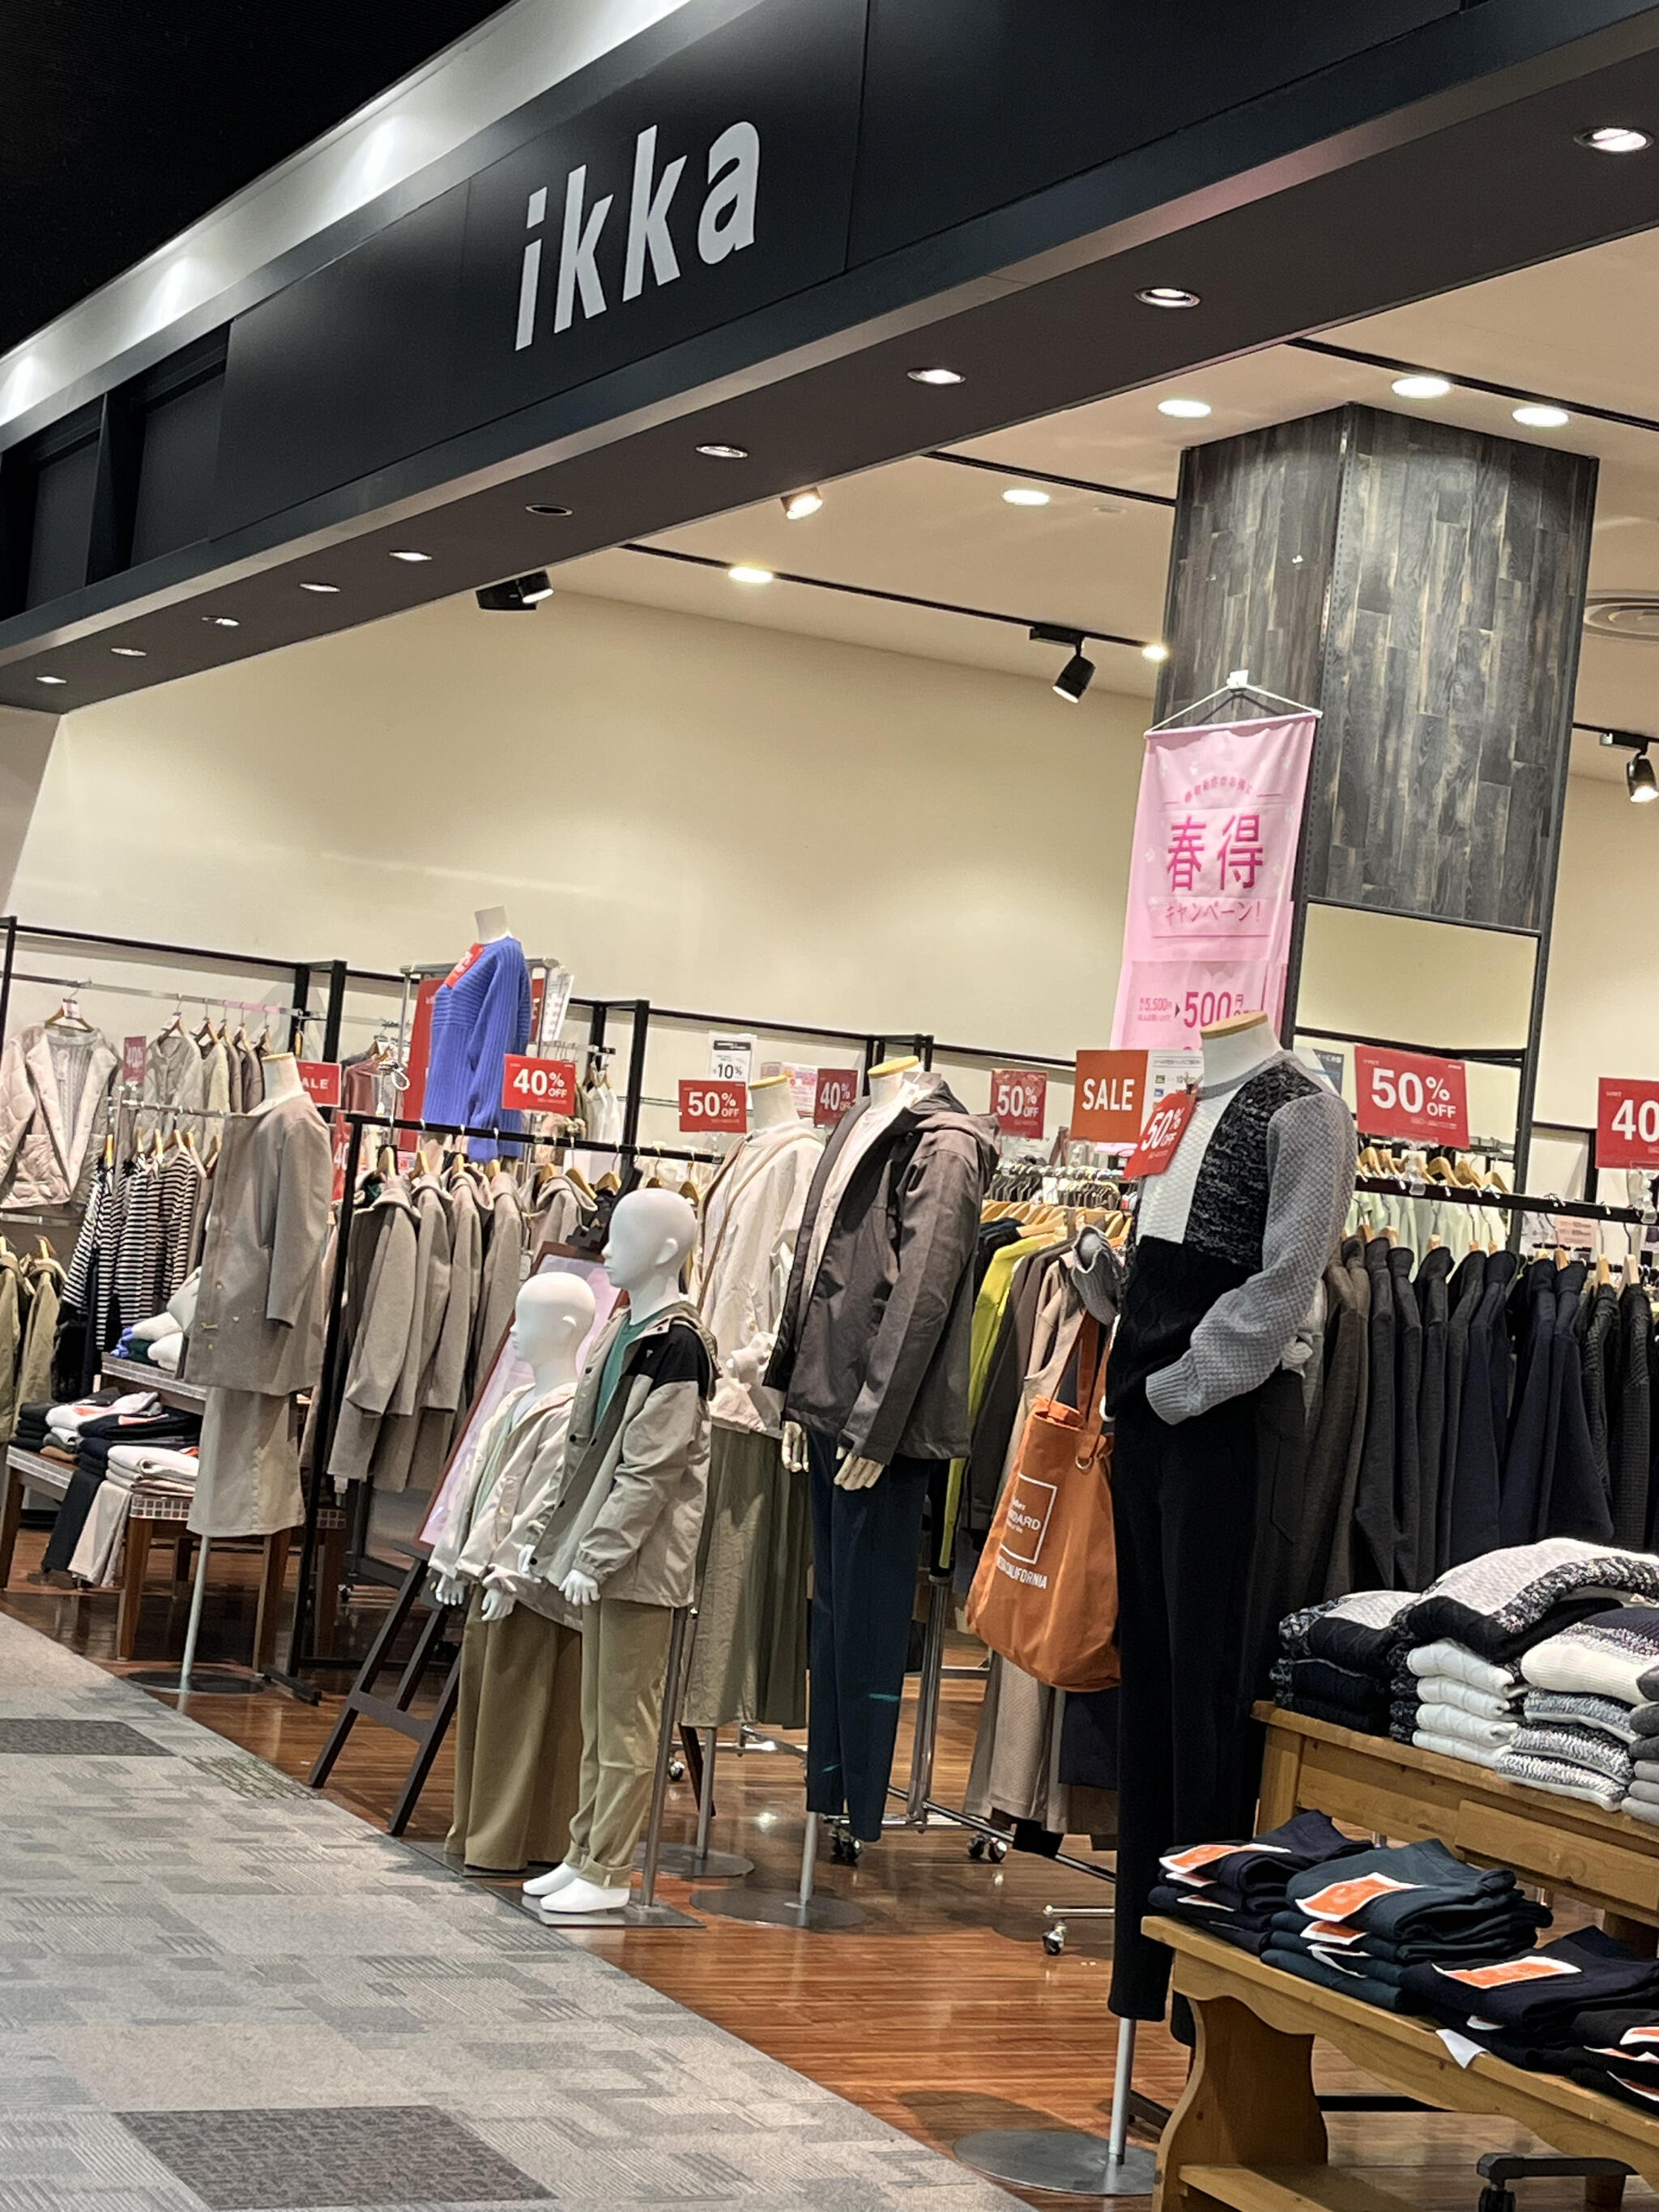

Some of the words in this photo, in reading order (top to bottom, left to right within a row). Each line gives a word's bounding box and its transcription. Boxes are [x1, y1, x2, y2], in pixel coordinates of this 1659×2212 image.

[515, 121, 760, 352] ikka
[1167, 814, 1263, 892] 春得
[302, 1077, 329, 1089] ALE
[513, 1068, 565, 1096] 40%
[548, 1087, 567, 1097] OFF
[1081, 1078, 1135, 1110] SALE
[1371, 1068, 1450, 1113] 50%
[688, 1091, 736, 1117] 50%
[721, 1107, 740, 1118] OFF
[996, 1085, 1037, 1117] 50%
[1023, 1106, 1039, 1117] OFF
[1427, 1102, 1456, 1119] OFF
